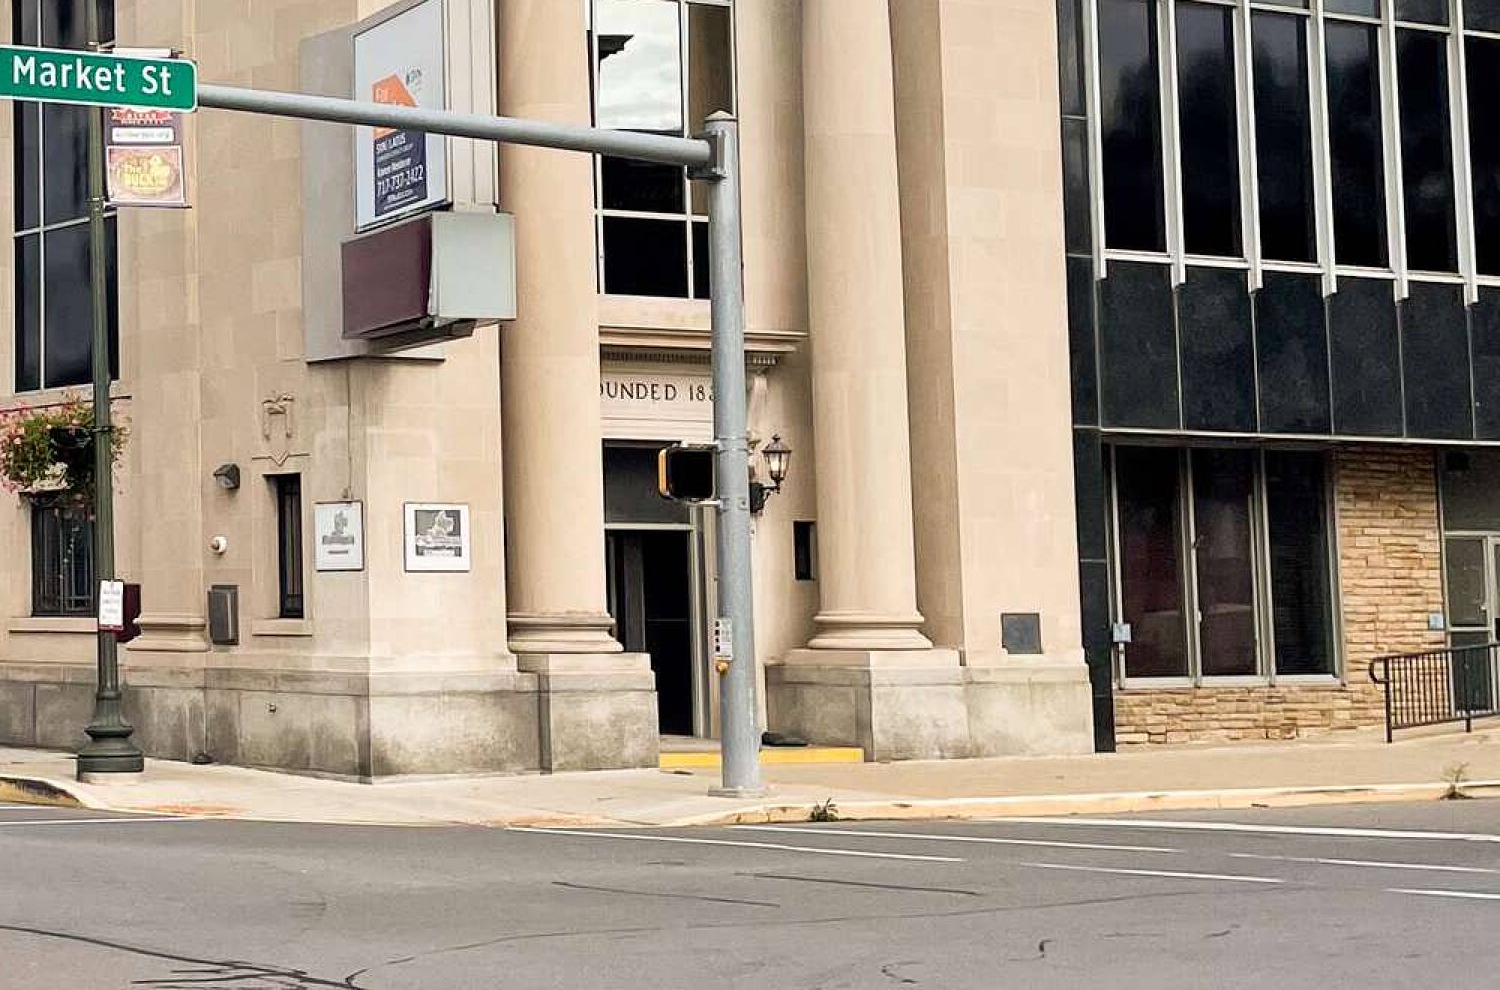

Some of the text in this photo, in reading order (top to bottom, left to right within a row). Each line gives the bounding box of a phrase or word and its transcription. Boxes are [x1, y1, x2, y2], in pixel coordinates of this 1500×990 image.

[12, 55, 172, 96] Market St
[600, 381, 678, 401] UNDED
